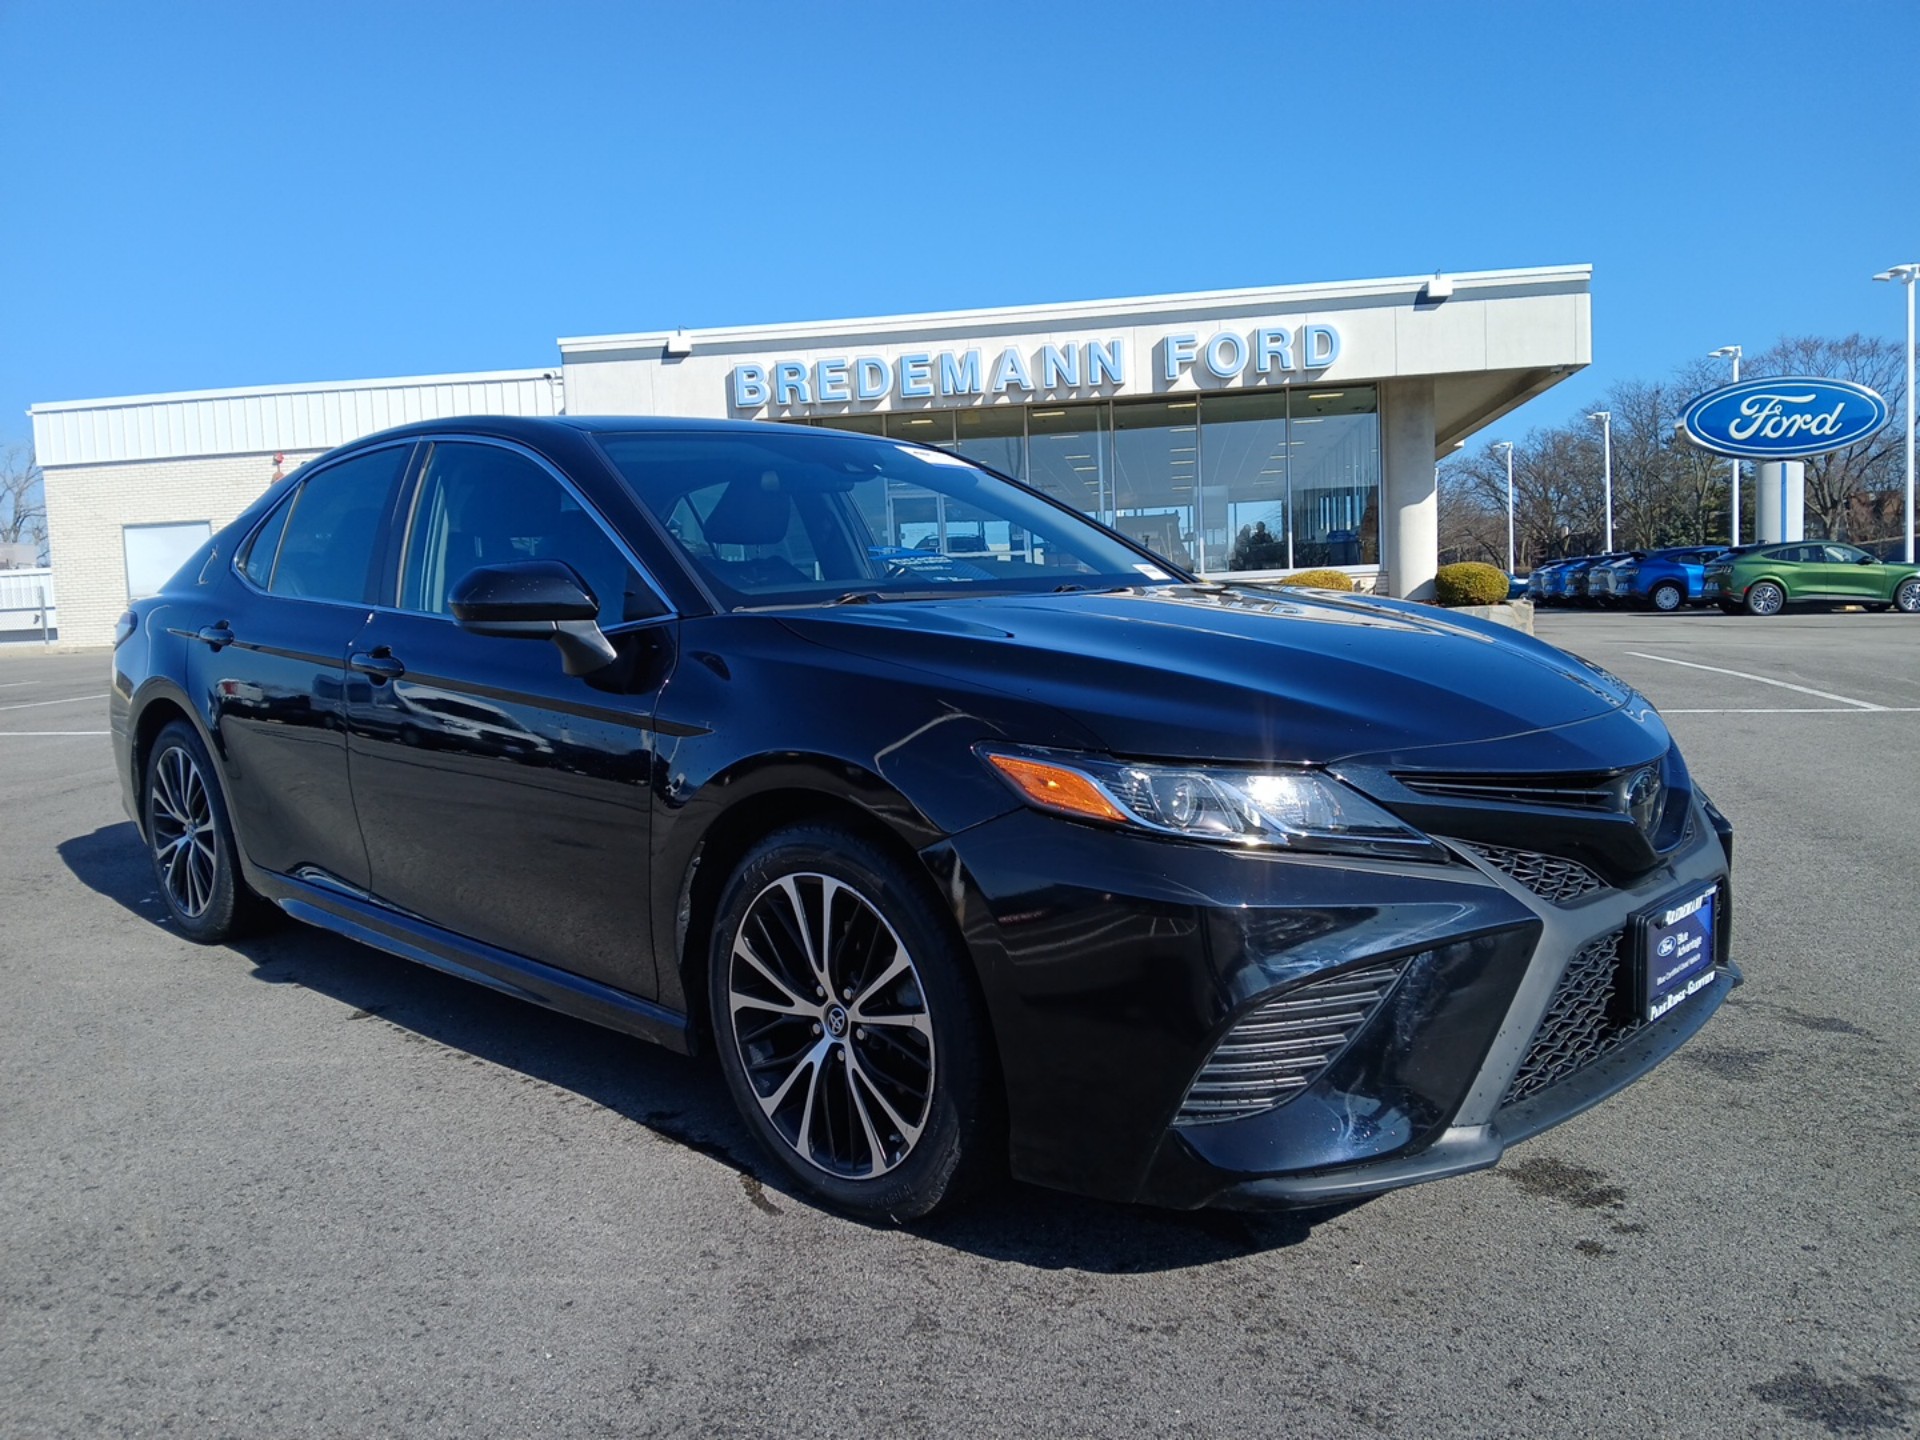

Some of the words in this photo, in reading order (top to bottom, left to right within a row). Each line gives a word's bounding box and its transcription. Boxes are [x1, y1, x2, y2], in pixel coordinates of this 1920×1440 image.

[733, 338, 1125, 409] BREDEMANN
[1164, 323, 1342, 382] FORD
[1728, 393, 1846, 441] Ford
